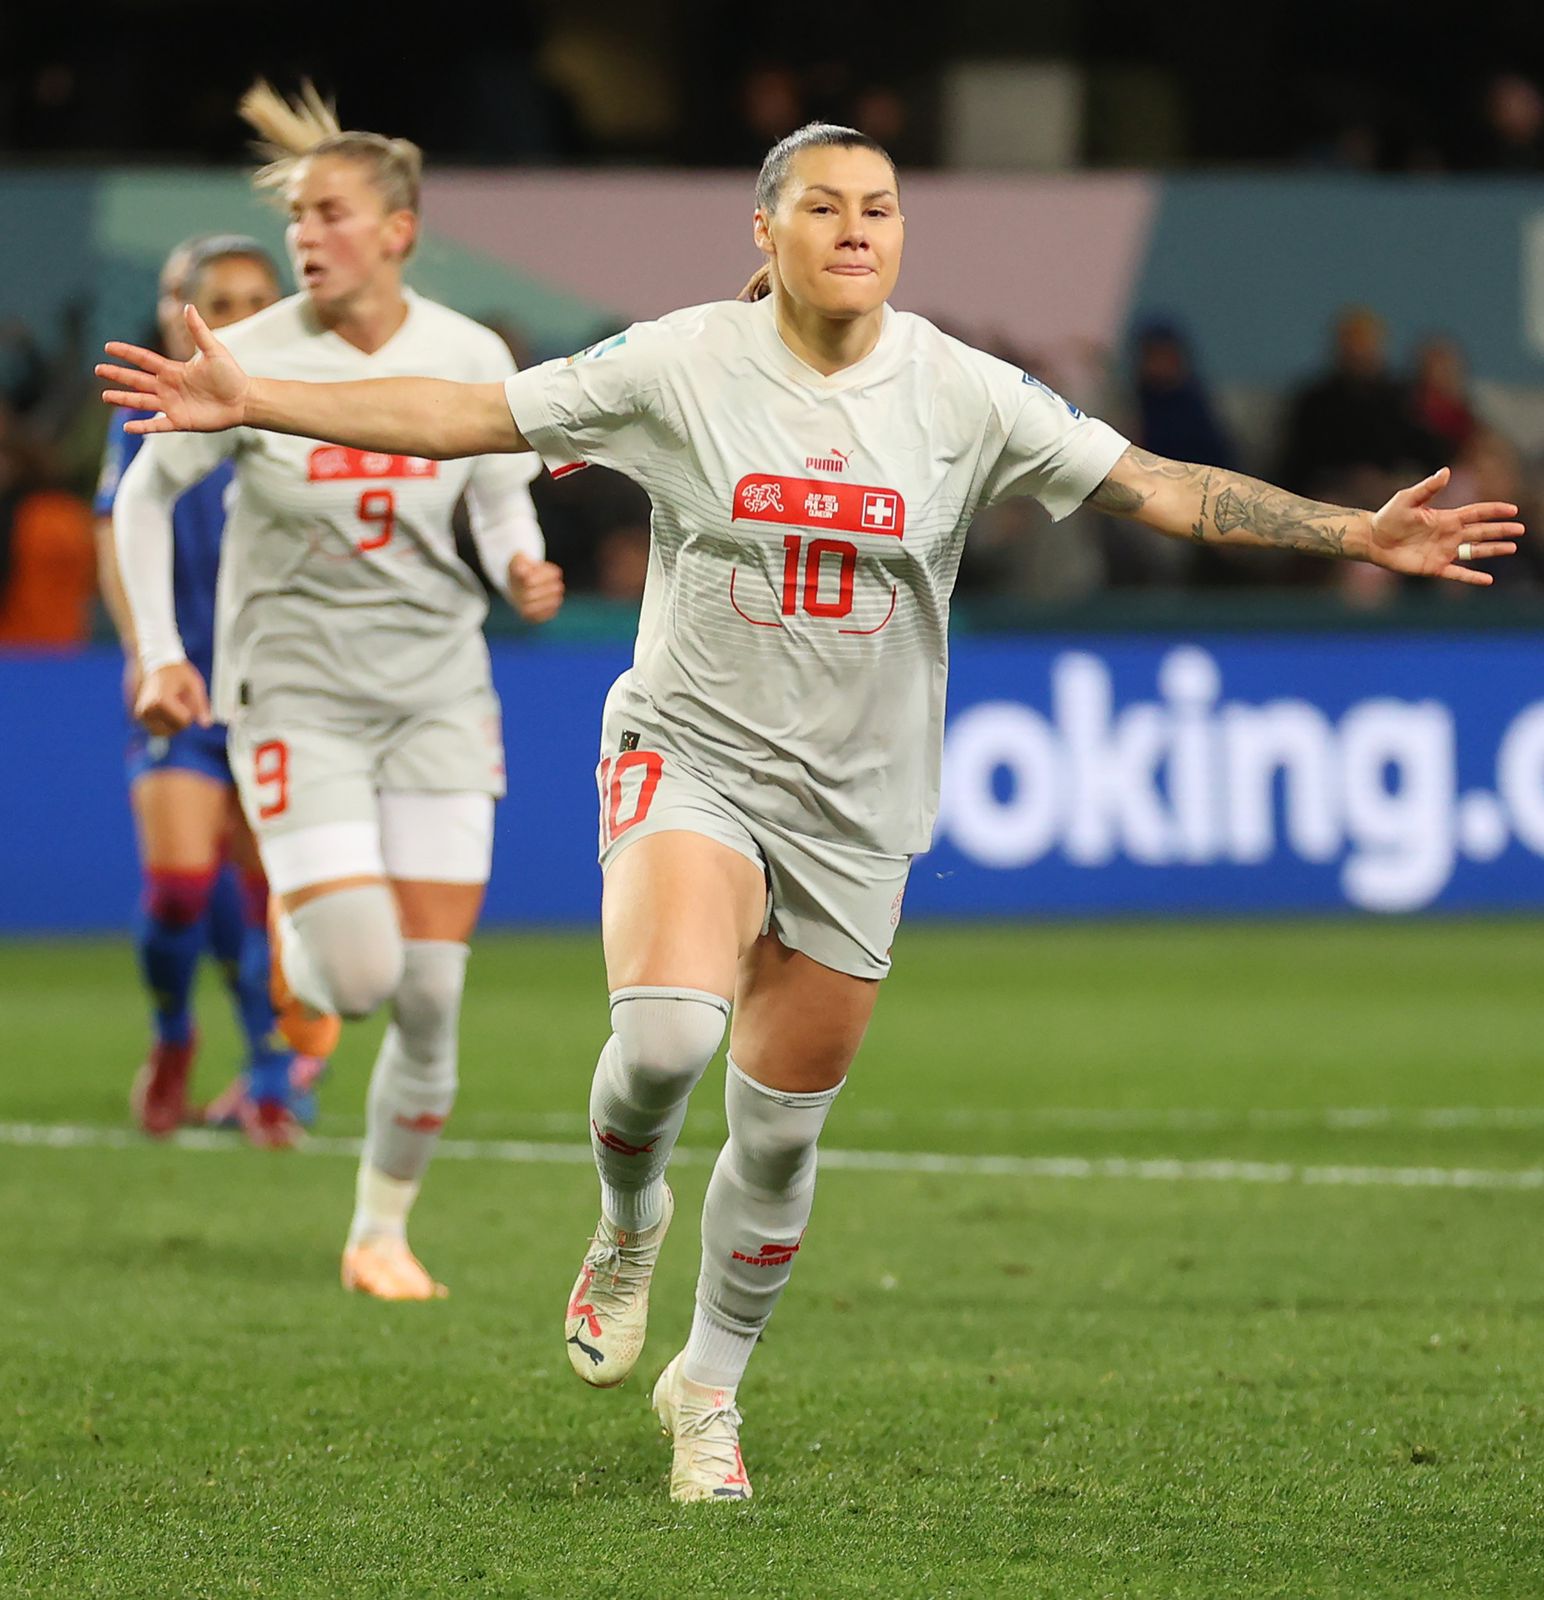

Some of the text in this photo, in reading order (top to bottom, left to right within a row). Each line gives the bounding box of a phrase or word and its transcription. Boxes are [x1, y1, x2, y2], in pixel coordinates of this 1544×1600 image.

[806, 457, 843, 472] PUMA
[358, 489, 394, 551] 9
[804, 499, 818, 510] PHI
[825, 502, 839, 512] SUI
[782, 535, 858, 618] 10
[255, 740, 289, 820] 9
[600, 751, 665, 848] 10
